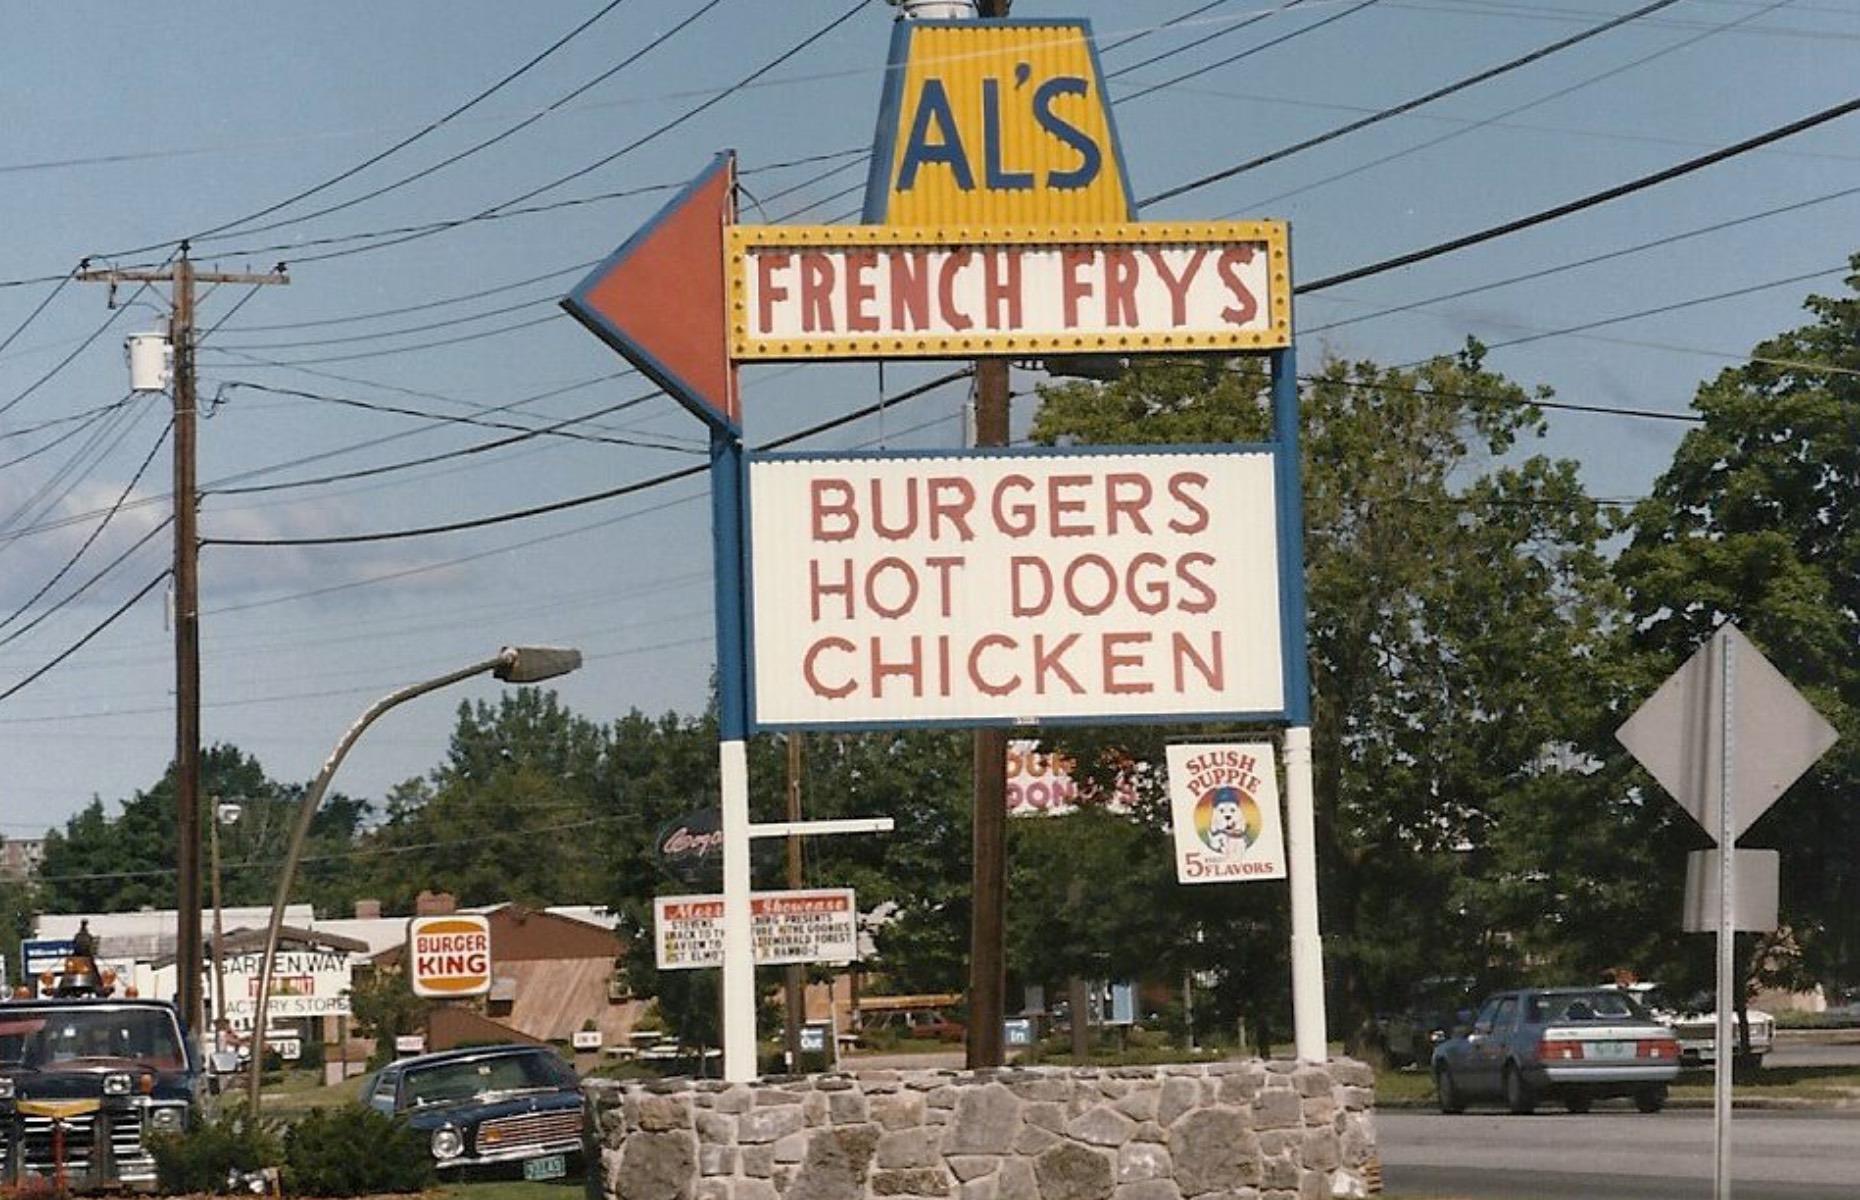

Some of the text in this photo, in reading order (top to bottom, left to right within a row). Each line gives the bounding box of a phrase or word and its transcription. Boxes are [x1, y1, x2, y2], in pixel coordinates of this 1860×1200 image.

[896, 62, 1102, 192] AL'S
[757, 245, 1022, 334] FRENCH
[810, 471, 1210, 542] BURGERS
[809, 552, 1218, 622] HOT DOGS
[803, 630, 1225, 700] CHICKEN
[1185, 750, 1257, 776] SLUSH
[1186, 767, 1262, 798] PUPPIE
[1185, 852, 1274, 878] 5 FLAVORS
[762, 898, 845, 912] Showcase
[416, 934, 487, 953] BURGER
[308, 953, 346, 972] WAY
[418, 954, 487, 976] KING
[226, 999, 289, 1013] ACTRY
